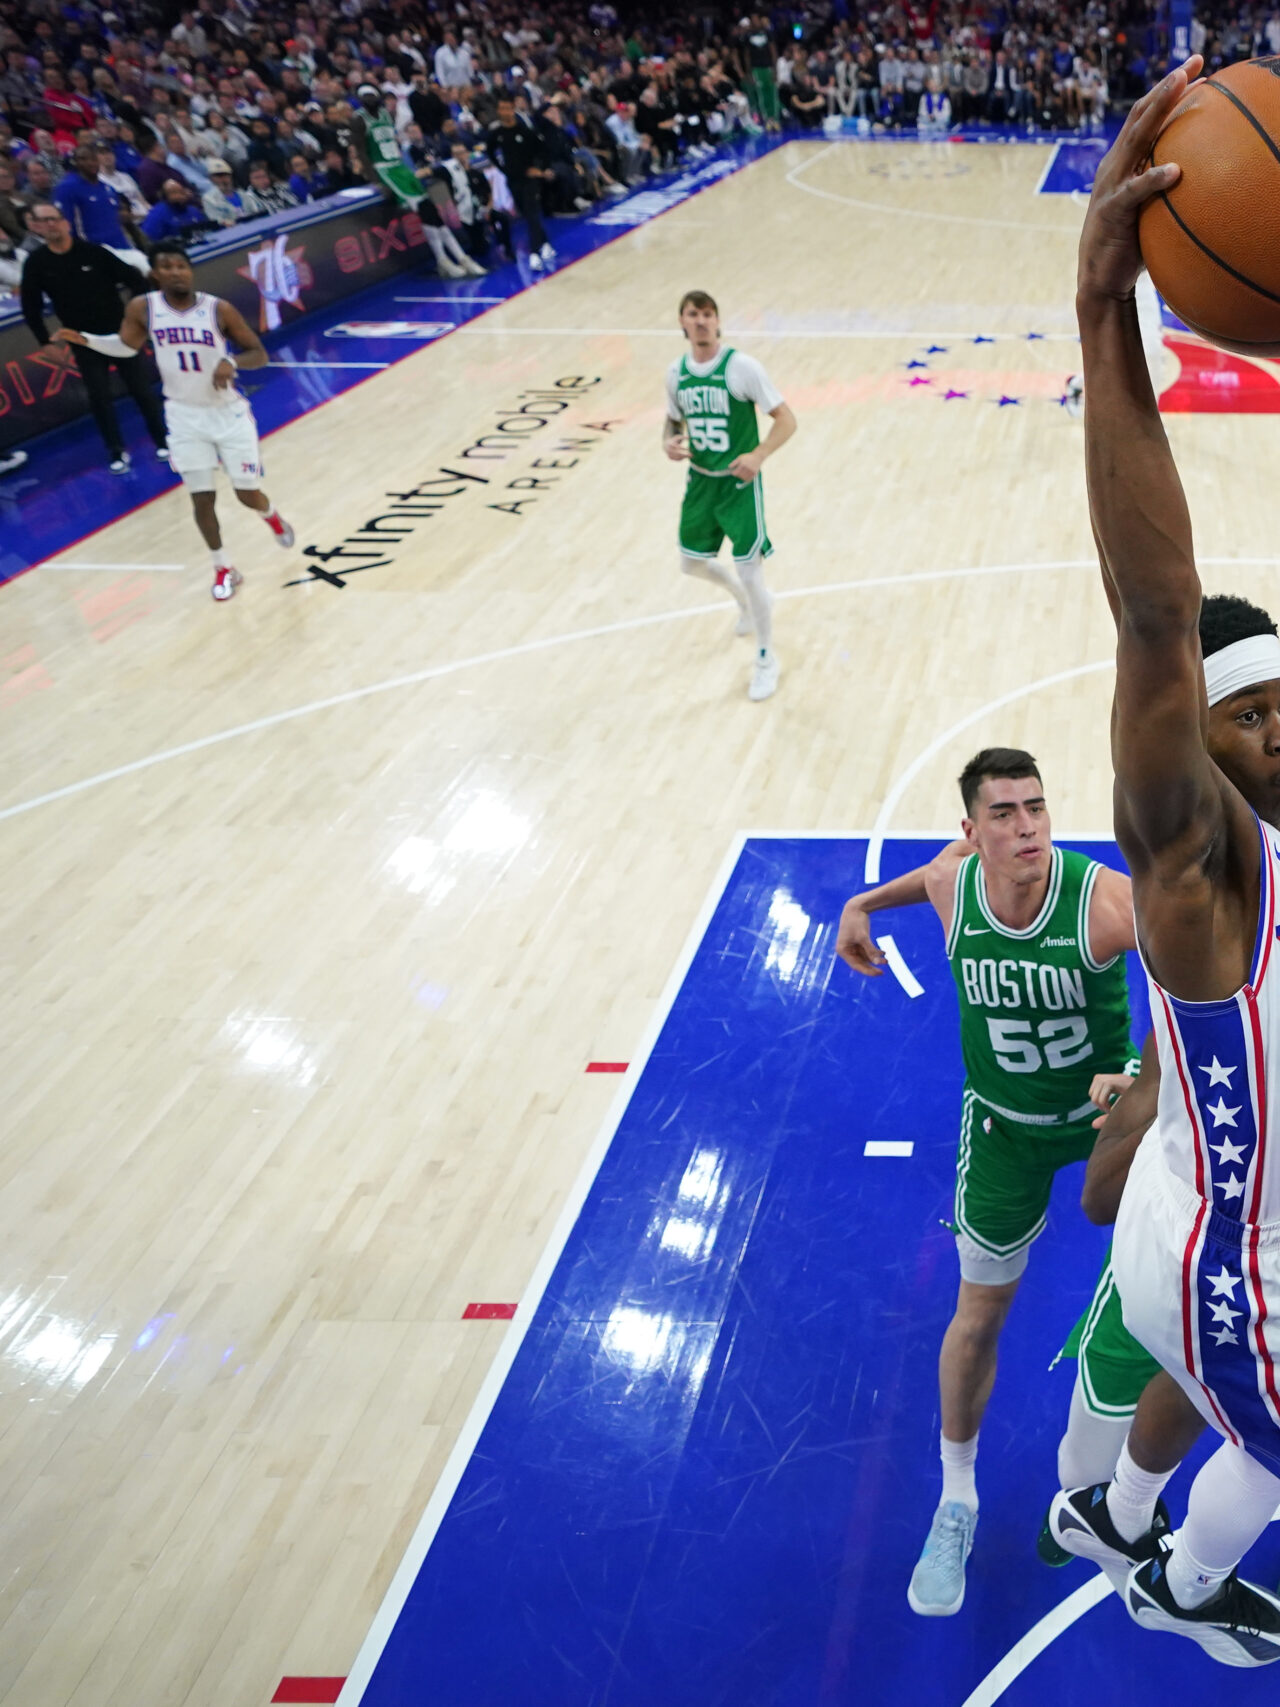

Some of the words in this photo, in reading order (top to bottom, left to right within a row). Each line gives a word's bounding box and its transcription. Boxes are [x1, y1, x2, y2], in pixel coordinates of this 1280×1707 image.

[153, 327, 215, 347] PHILA
[178, 351, 202, 373] 11
[687, 418, 730, 452] 55
[282, 468, 489, 588] xfinity
[457, 376, 601, 460] mobile
[487, 419, 623, 515] ARENA
[1040, 936, 1076, 948] Amica
[961, 958, 1087, 1011] BOSTON
[985, 1016, 1094, 1074] 52
